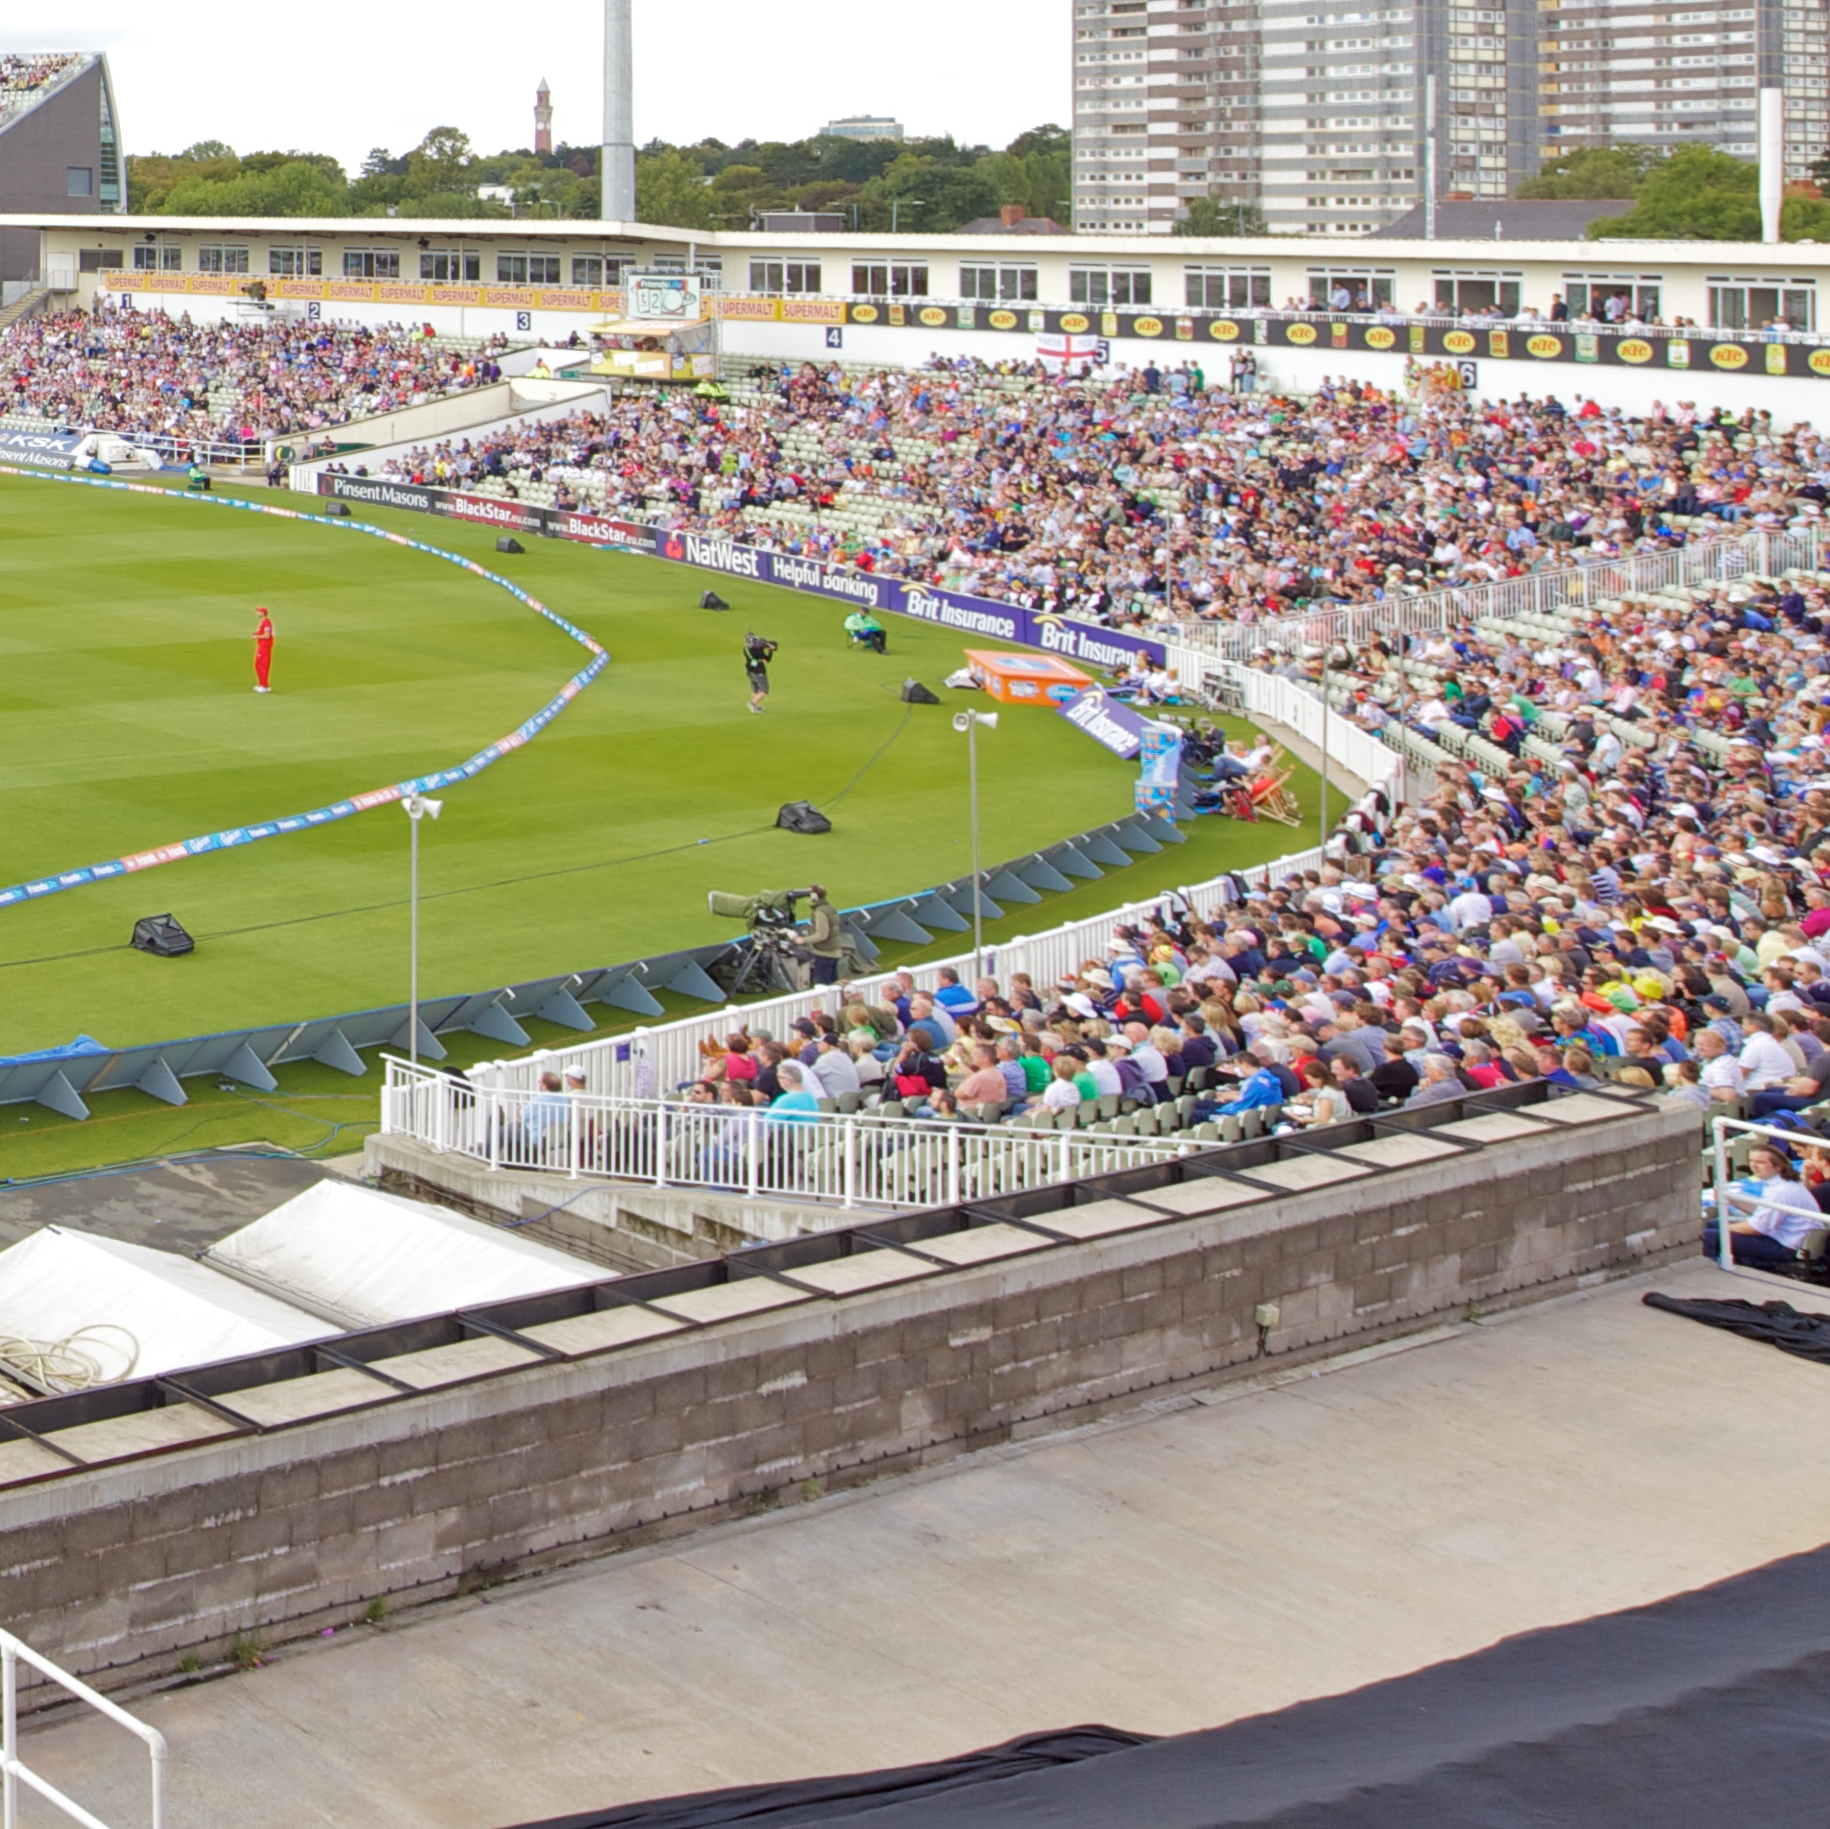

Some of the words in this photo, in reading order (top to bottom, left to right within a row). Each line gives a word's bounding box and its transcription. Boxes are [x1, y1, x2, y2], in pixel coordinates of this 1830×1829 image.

[108, 277, 144, 288] SUPERMALT
[381, 287, 425, 300] SUPERMALT
[433, 289, 479, 303] SUPERMALT
[487, 291, 533, 305] SUPERMALT
[542, 293, 591, 307] SUPERMALT
[784, 303, 840, 318] SUPERMALT
[8, 435, 72, 451] KSK
[27, 450, 69, 469] Masons
[334, 475, 381, 501] Pinsent
[382, 483, 429, 508] Masons
[436, 498, 541, 529] www.BlackStar.eu.com
[548, 518, 656, 549] www.BlackStar.eu.com
[686, 534, 759, 578] NatWest
[774, 556, 820, 587] Helpful
[907, 591, 939, 621] Brit
[941, 601, 1015, 638] Insurance
[1041, 621, 1076, 656] Brit
[1078, 632, 1136, 667] Insuran
